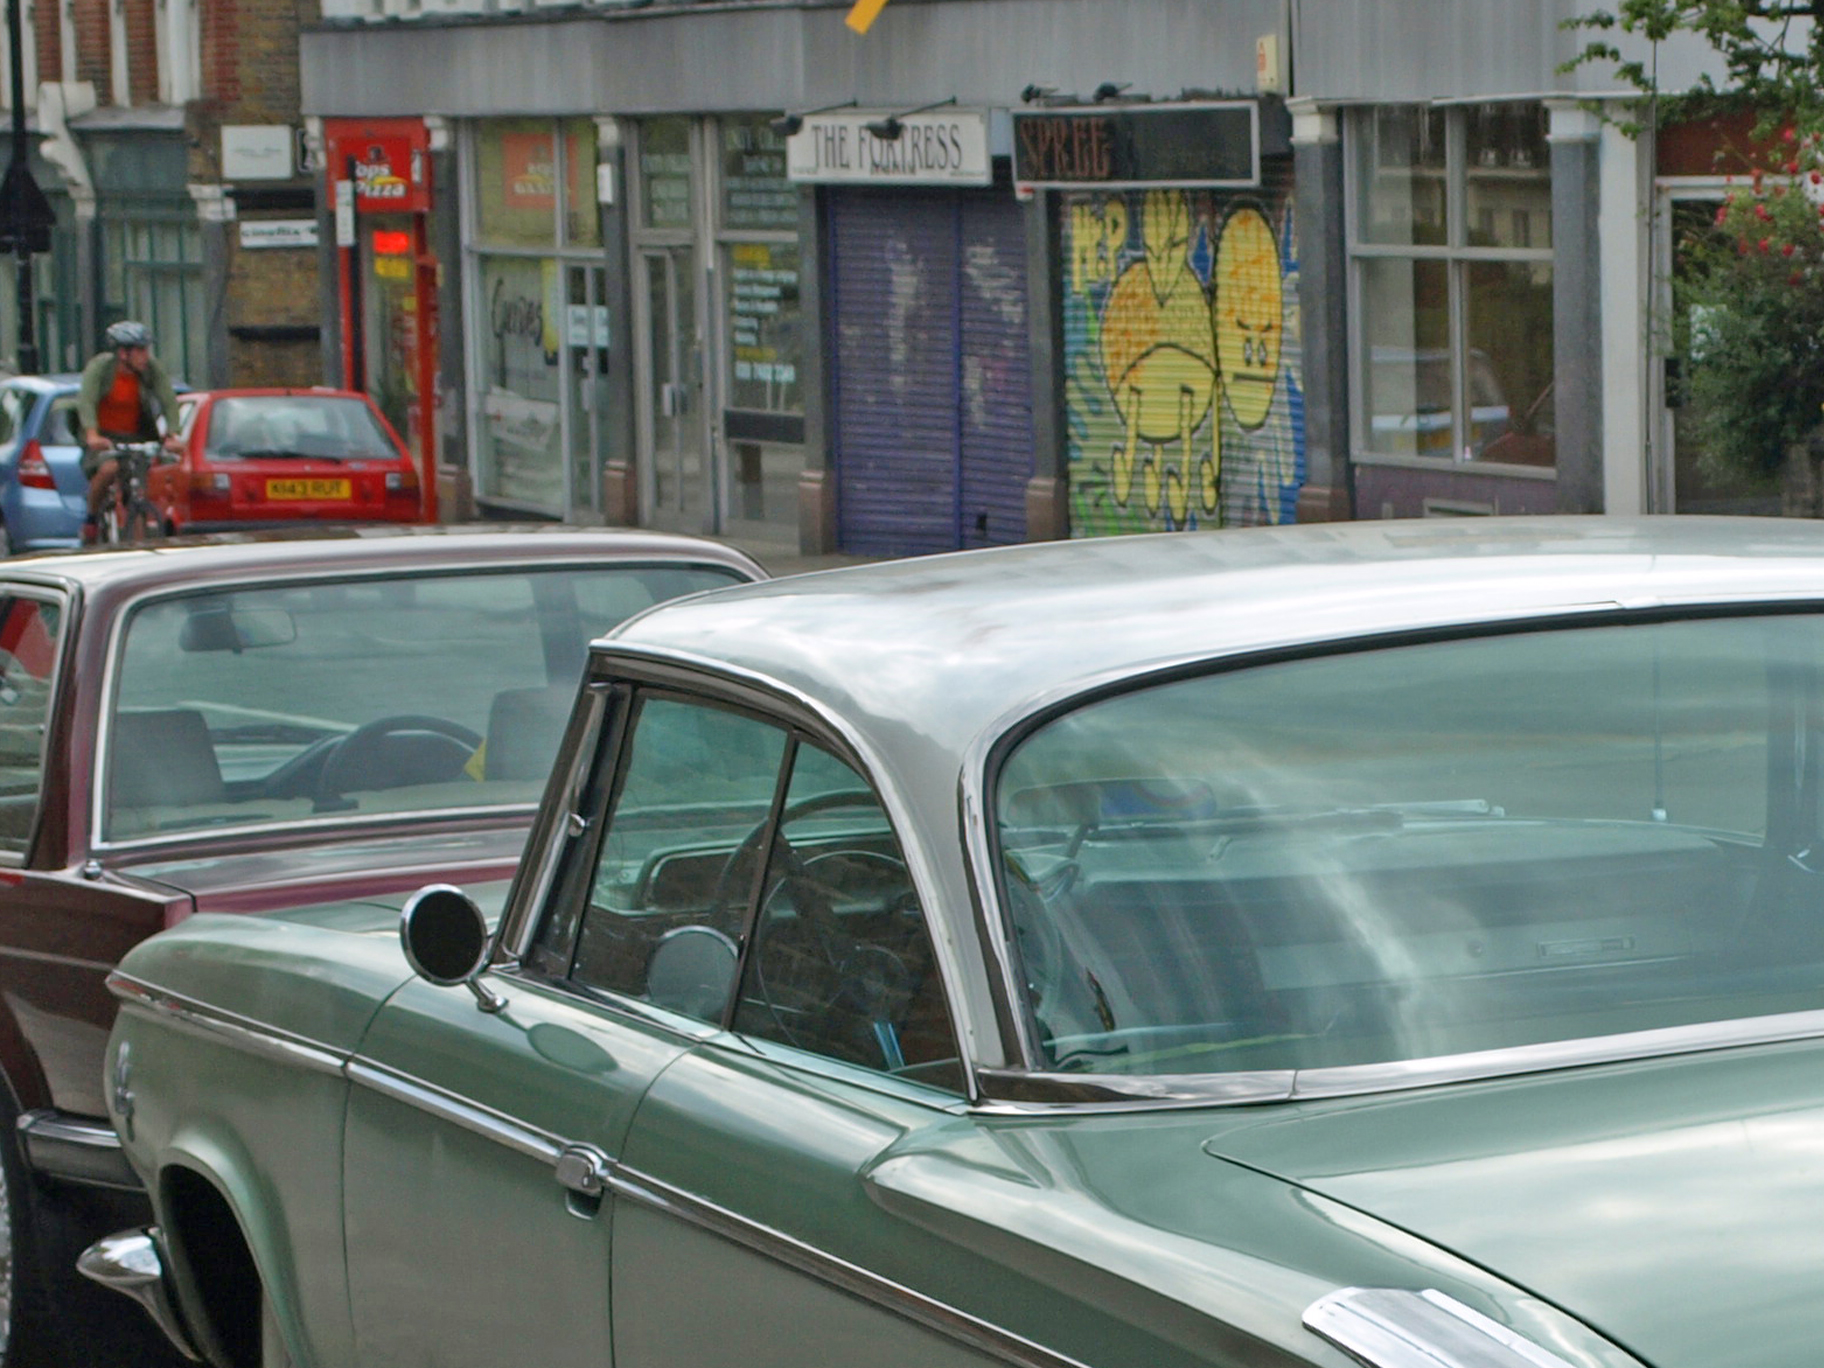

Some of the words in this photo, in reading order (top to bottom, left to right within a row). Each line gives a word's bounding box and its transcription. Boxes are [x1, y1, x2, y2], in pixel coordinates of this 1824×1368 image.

[811, 124, 850, 169] THE
[857, 124, 962, 171] FORTRESS
[355, 161, 391, 181] ops
